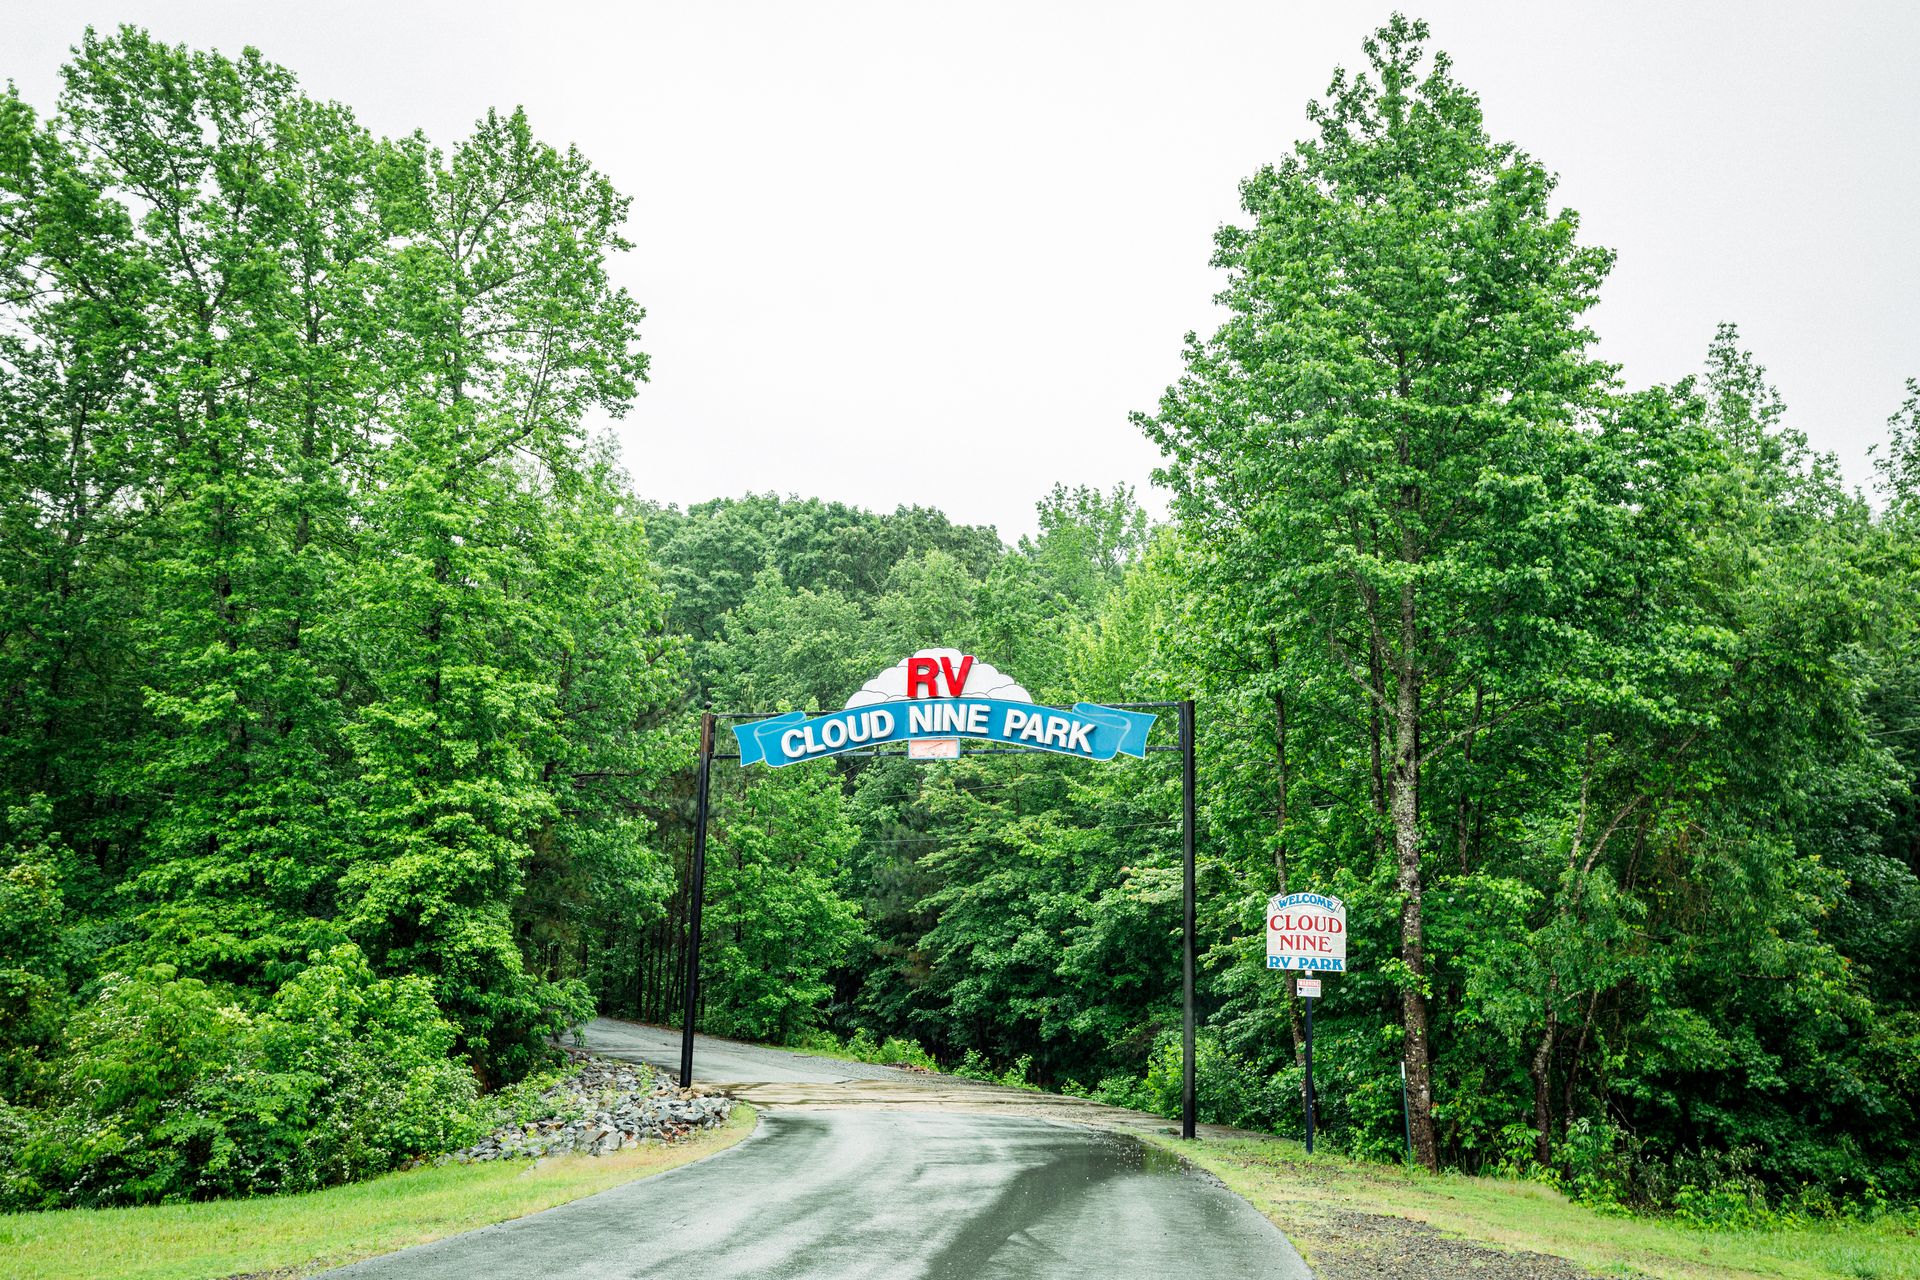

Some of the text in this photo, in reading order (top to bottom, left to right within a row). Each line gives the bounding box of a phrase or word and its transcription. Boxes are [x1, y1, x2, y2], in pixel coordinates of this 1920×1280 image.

[906, 655, 974, 698] RV
[780, 703, 1097, 758] CLOUD NINE PARK
[1279, 894, 1334, 910] WELCOME
[1269, 915, 1343, 934] CLOUD
[1280, 935, 1333, 953] NINE
[1269, 956, 1343, 970] RV PARK
